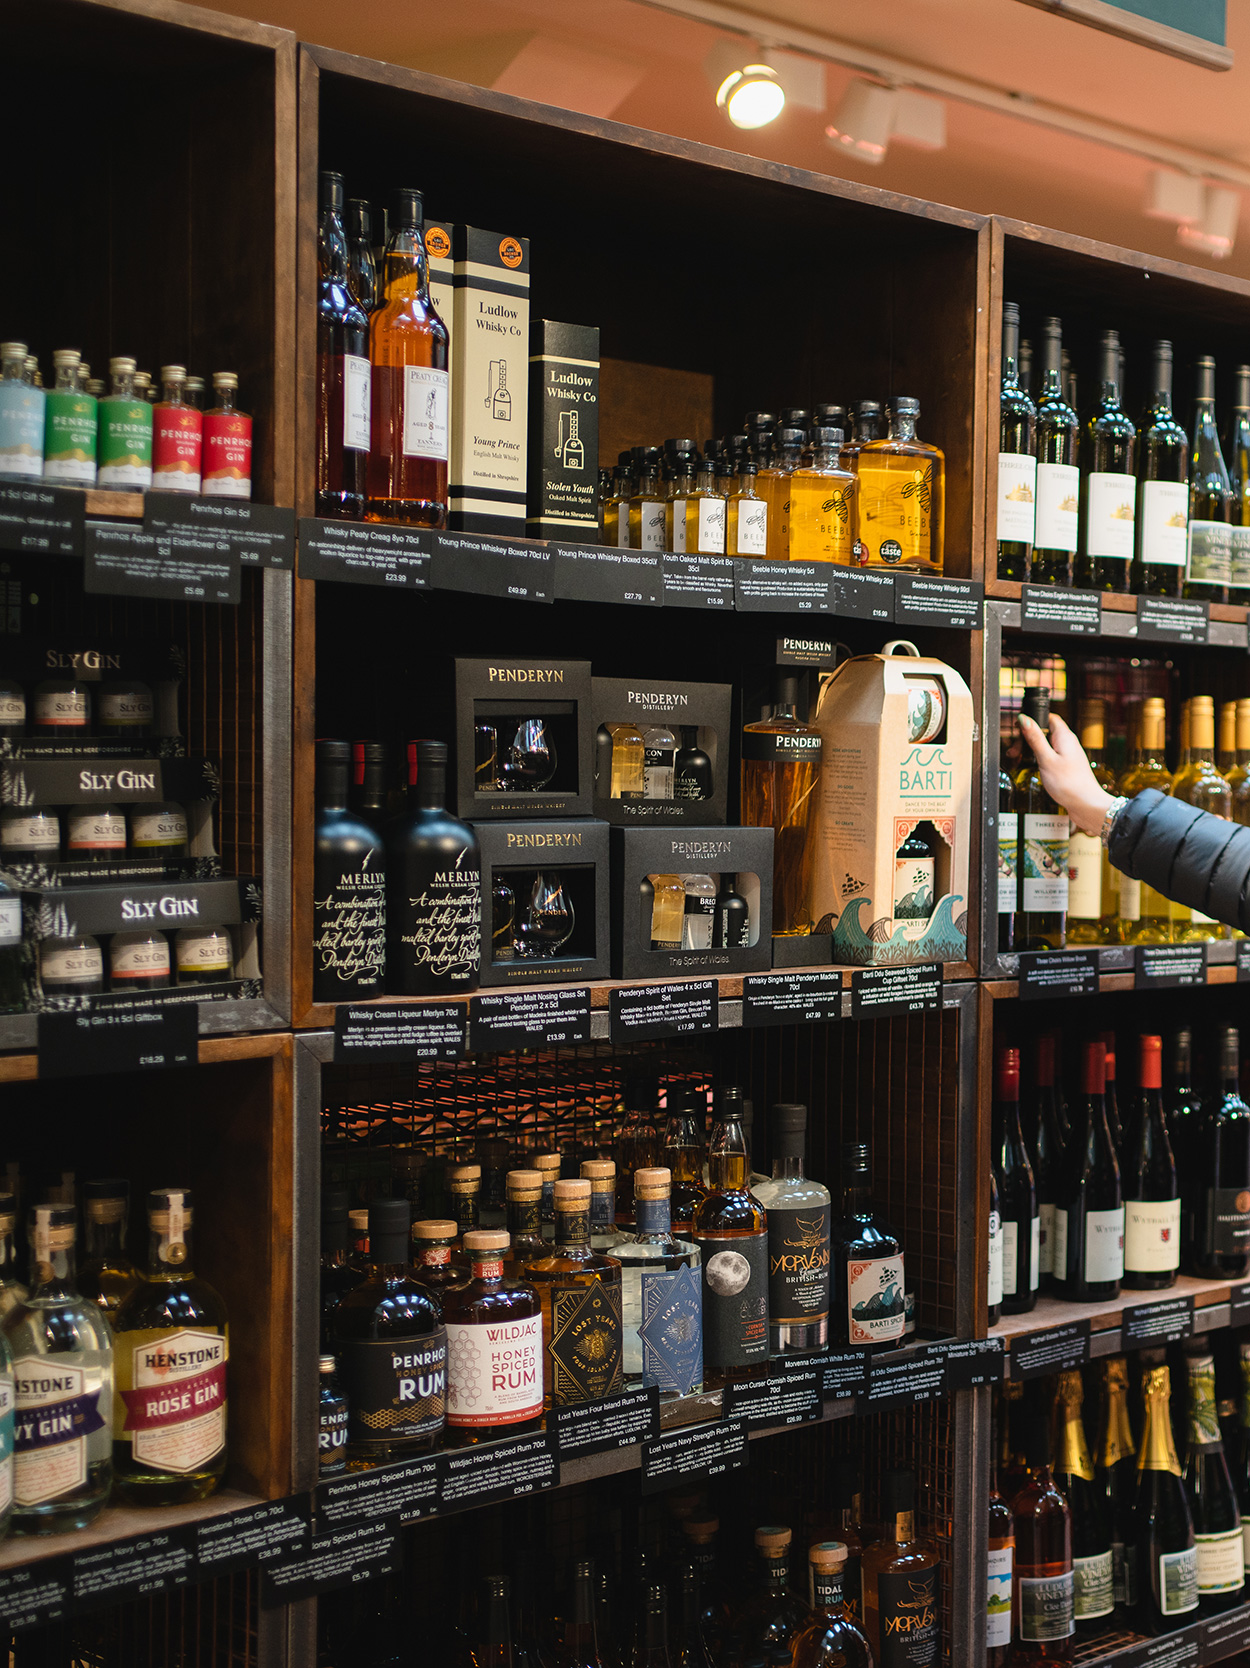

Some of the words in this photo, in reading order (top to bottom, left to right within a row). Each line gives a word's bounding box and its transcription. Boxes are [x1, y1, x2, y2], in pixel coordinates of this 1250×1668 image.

[479, 301, 518, 320] Ludlow
[476, 319, 508, 336] Whisky
[510, 324, 522, 337] Co
[411, 370, 430, 382] PEATY
[551, 370, 593, 387] Ludlow
[547, 387, 580, 403] Whisky
[583, 391, 596, 404] Co
[473, 436, 496, 449] Young
[498, 440, 520, 451] Prince
[226, 452, 245, 462] GIN
[473, 450, 490, 460] English
[492, 452, 502, 460] Malt
[503, 453, 520, 462] Whisky
[472, 470, 491, 478] Distilled
[498, 473, 520, 482] Shropshire
[546, 481, 572, 492] Stolen
[573, 483, 594, 494] Youth
[548, 494, 564, 502] Oaked
[578, 496, 592, 504] Spirit
[190, 504, 222, 516] Penrhos
[224, 506, 236, 516] Gin
[238, 508, 250, 517] 5cl
[572, 511, 595, 520] Shropshire
[324, 526, 348, 538] Whisky
[350, 530, 369, 540] Peaty
[370, 532, 390, 542] Creag
[392, 534, 404, 543] 8yo
[406, 536, 419, 544] 70cl
[438, 536, 458, 548] Young
[460, 540, 480, 550] Prince
[482, 542, 506, 554] Whiskey
[508, 547, 527, 556] Boxed
[528, 550, 542, 558] 70cl
[880, 548, 901, 556] taste
[558, 548, 576, 560] Young
[578, 552, 596, 560] Prince
[598, 553, 621, 564] Whiskey
[622, 556, 640, 564] Boxed
[663, 554, 678, 562] Youth
[680, 556, 697, 564] Oaked
[711, 558, 724, 567] Spirit
[752, 565, 769, 574] Beeble
[770, 566, 788, 576] Honey
[788, 567, 806, 576] Whisky
[386, 574, 406, 582] £23.99
[508, 586, 527, 594] £49.99
[624, 592, 642, 600] £27.79
[784, 638, 832, 652] PENDERYN
[46, 651, 81, 668] SLY
[83, 651, 121, 669] GIN
[488, 668, 564, 683] PENDERYN
[628, 691, 688, 706] PENDERYN
[80, 771, 116, 790] SLY
[116, 771, 155, 790] GIN
[900, 770, 952, 790] BARTI
[623, 806, 636, 814] The
[638, 805, 654, 816] Spirit
[655, 806, 662, 815] of
[507, 834, 582, 848] PENDERYN
[671, 841, 731, 854] PENDERYN
[340, 872, 385, 884] MERLYN
[434, 871, 480, 882] MERLYN
[122, 900, 158, 918] SLY
[159, 898, 198, 916] GIN
[669, 956, 682, 966] The
[684, 956, 700, 968] Spirit
[701, 956, 708, 964] of
[749, 976, 767, 986] Whisky
[768, 976, 784, 984] Single
[784, 974, 796, 982] Malt
[796, 974, 819, 983] Penderyn
[619, 989, 645, 998] Penderyn
[646, 987, 660, 996] Spirit
[668, 984, 684, 993] Wales
[694, 982, 702, 990] 5cl
[480, 996, 503, 1006] Whisky
[504, 995, 522, 1004] Single
[524, 994, 536, 1002] Malt
[538, 992, 558, 1002] Nosing
[558, 991, 575, 999] Glass
[576, 990, 586, 998] Set
[662, 994, 672, 1002] Set
[510, 1002, 538, 1012] Penderyn
[550, 1000, 558, 1008] 5cl
[349, 1010, 373, 1020] Whisky
[374, 1010, 396, 1018] Cream
[398, 1010, 422, 1019] Liqueur
[423, 1010, 444, 1018] Merlyn
[446, 1008, 458, 1016] 70cl
[546, 1033, 566, 1041] £13.99
[417, 1048, 438, 1056] £20.99
[572, 1318, 592, 1336] LOST
[596, 1314, 617, 1330] YEARS
[870, 1320, 890, 1329] BARTI
[486, 1322, 536, 1342] WILDJAC
[146, 1346, 220, 1368] HENSTONE
[492, 1345, 536, 1362] HONEY
[492, 1359, 536, 1374] SPICED
[400, 1370, 444, 1400] RUM
[492, 1368, 536, 1392] RUM
[146, 1392, 190, 1418] ROSÉ
[195, 1382, 218, 1405] GIN
[558, 1412, 571, 1421] Lost
[572, 1408, 588, 1418] Years
[589, 1404, 602, 1414] Four
[604, 1400, 621, 1410] Island
[622, 1396, 636, 1406] Rum
[636, 1393, 648, 1403] 70cl
[618, 1437, 636, 1446] £44.99
[449, 1458, 473, 1470] Wildjac
[474, 1453, 493, 1465] Honey
[494, 1448, 516, 1459] Spiced
[517, 1444, 532, 1454] Rum
[533, 1440, 546, 1450] 70cl
[328, 1483, 357, 1496] Penrhos
[358, 1478, 380, 1490] Honey
[382, 1473, 404, 1484] Spiced
[406, 1468, 421, 1477] Rum
[422, 1463, 436, 1473] 70cl
[514, 1484, 533, 1494] £34.99
[817, 1584, 842, 1595] TIDAL
